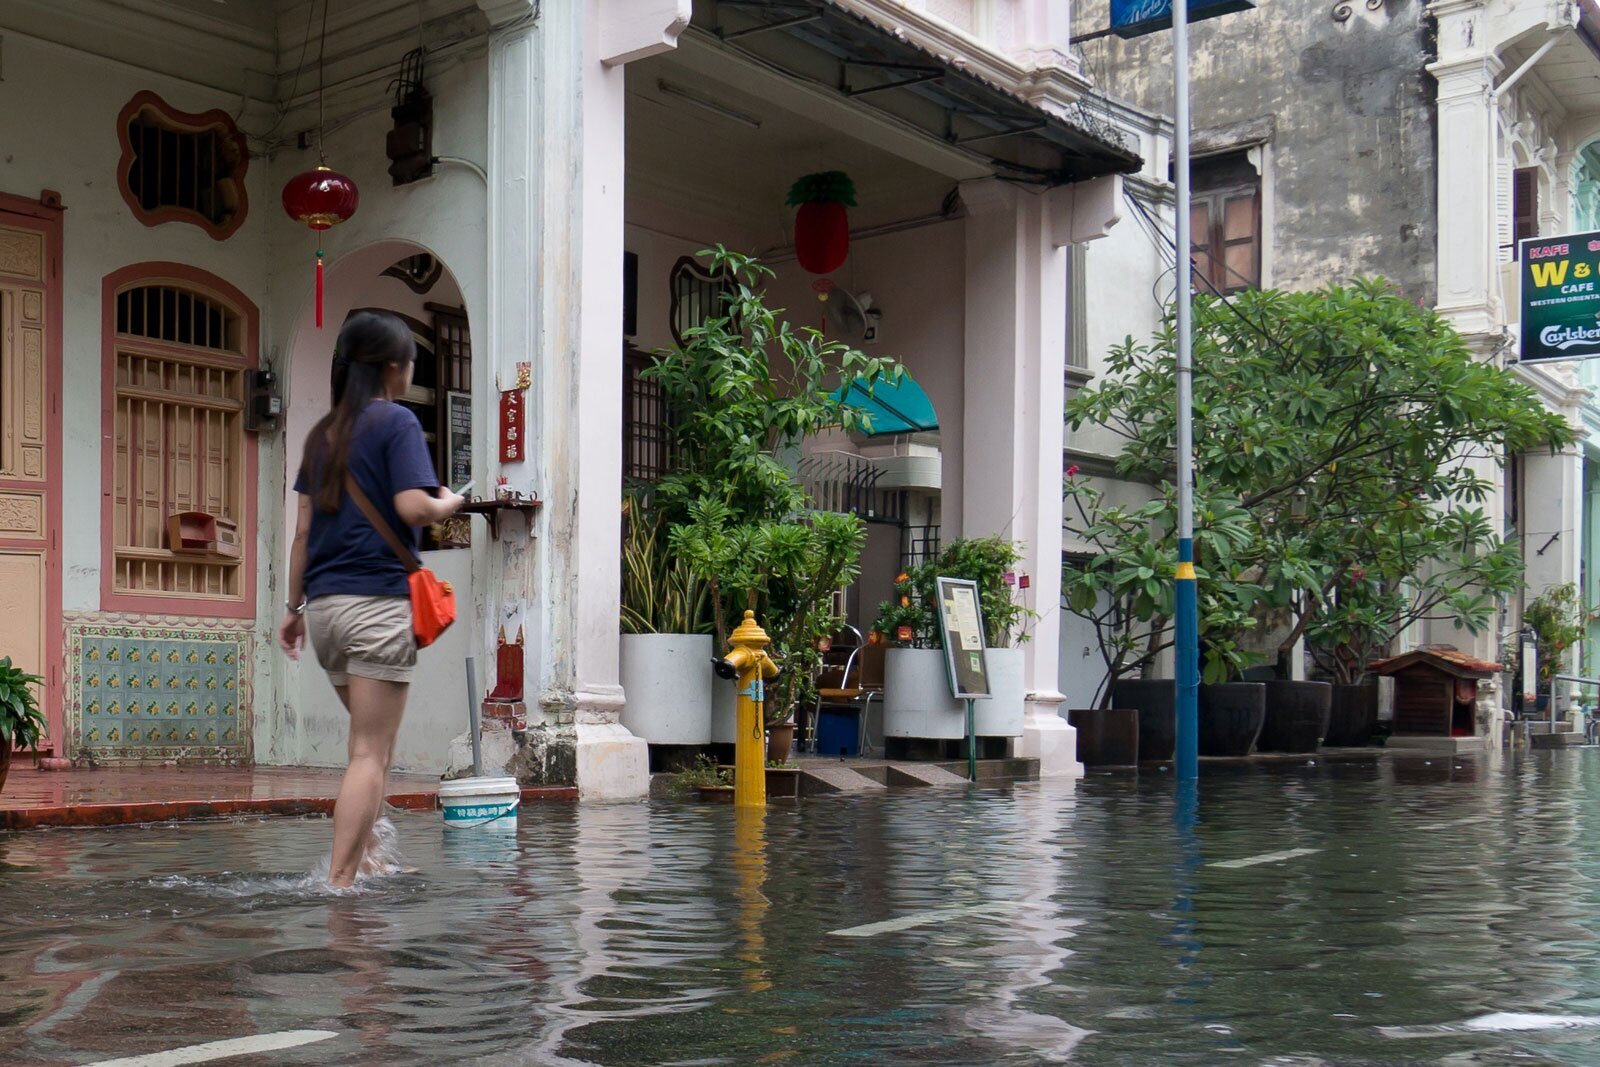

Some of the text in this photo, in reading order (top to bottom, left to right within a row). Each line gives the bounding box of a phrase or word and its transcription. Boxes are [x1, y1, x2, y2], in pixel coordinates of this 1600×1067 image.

[1530, 244, 1569, 259] KAFE
[1530, 260, 1591, 288] W &
[1561, 282, 1594, 294] CAFE
[1530, 293, 1600, 307] WESTERN ORIENTA
[1540, 324, 1600, 347] Carlsber
